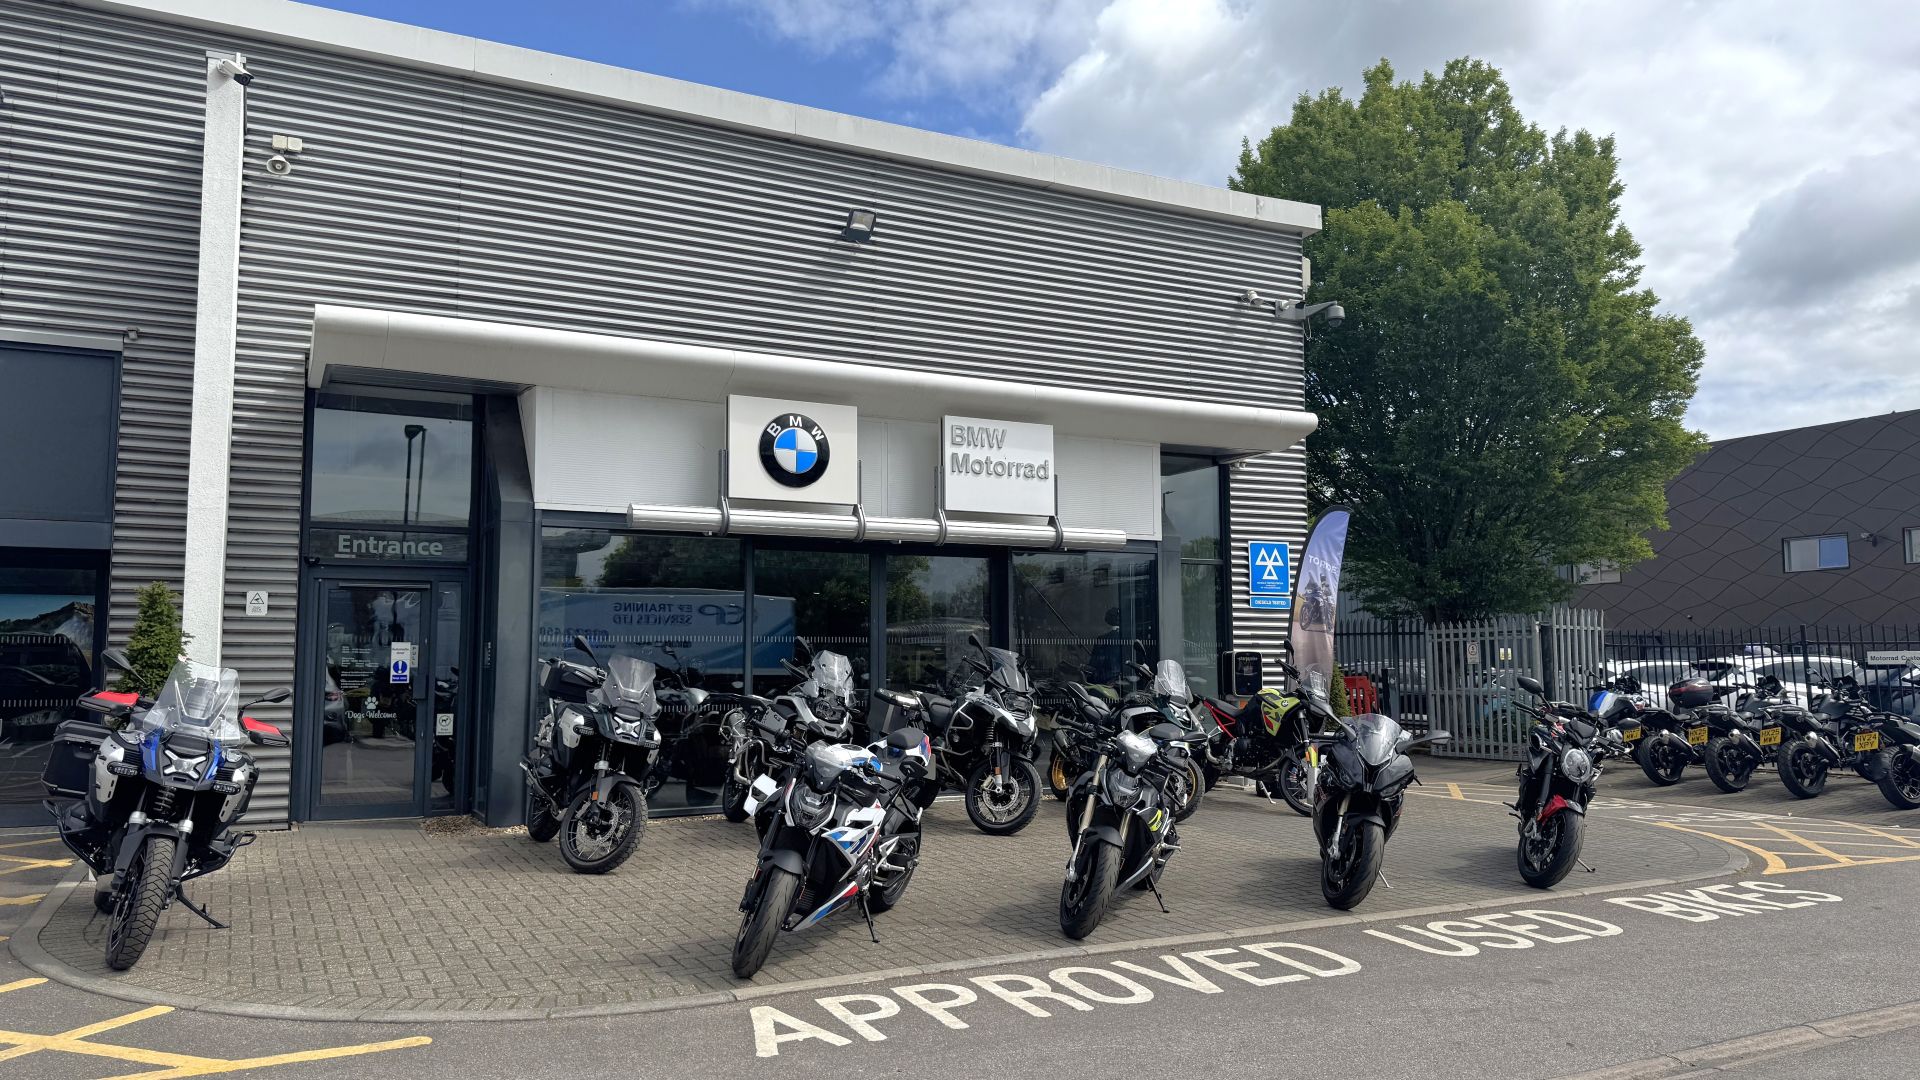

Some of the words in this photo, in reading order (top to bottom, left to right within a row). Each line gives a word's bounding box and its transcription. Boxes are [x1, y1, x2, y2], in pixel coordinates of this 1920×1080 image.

[766, 415, 824, 440] BMW
[951, 425, 1007, 449] BMW
[951, 452, 1049, 480] Motorrad
[338, 534, 443, 556] Entrance
[344, 710, 365, 723] Dogs
[366, 709, 397, 719] Welcome
[1761, 729, 1780, 737] HX25
[1856, 734, 1877, 743] HV24
[1859, 741, 1875, 749] XPY
[749, 942, 1363, 1058] APPROVED
[1362, 909, 1624, 957] USED
[1603, 881, 1844, 922] BIKES
